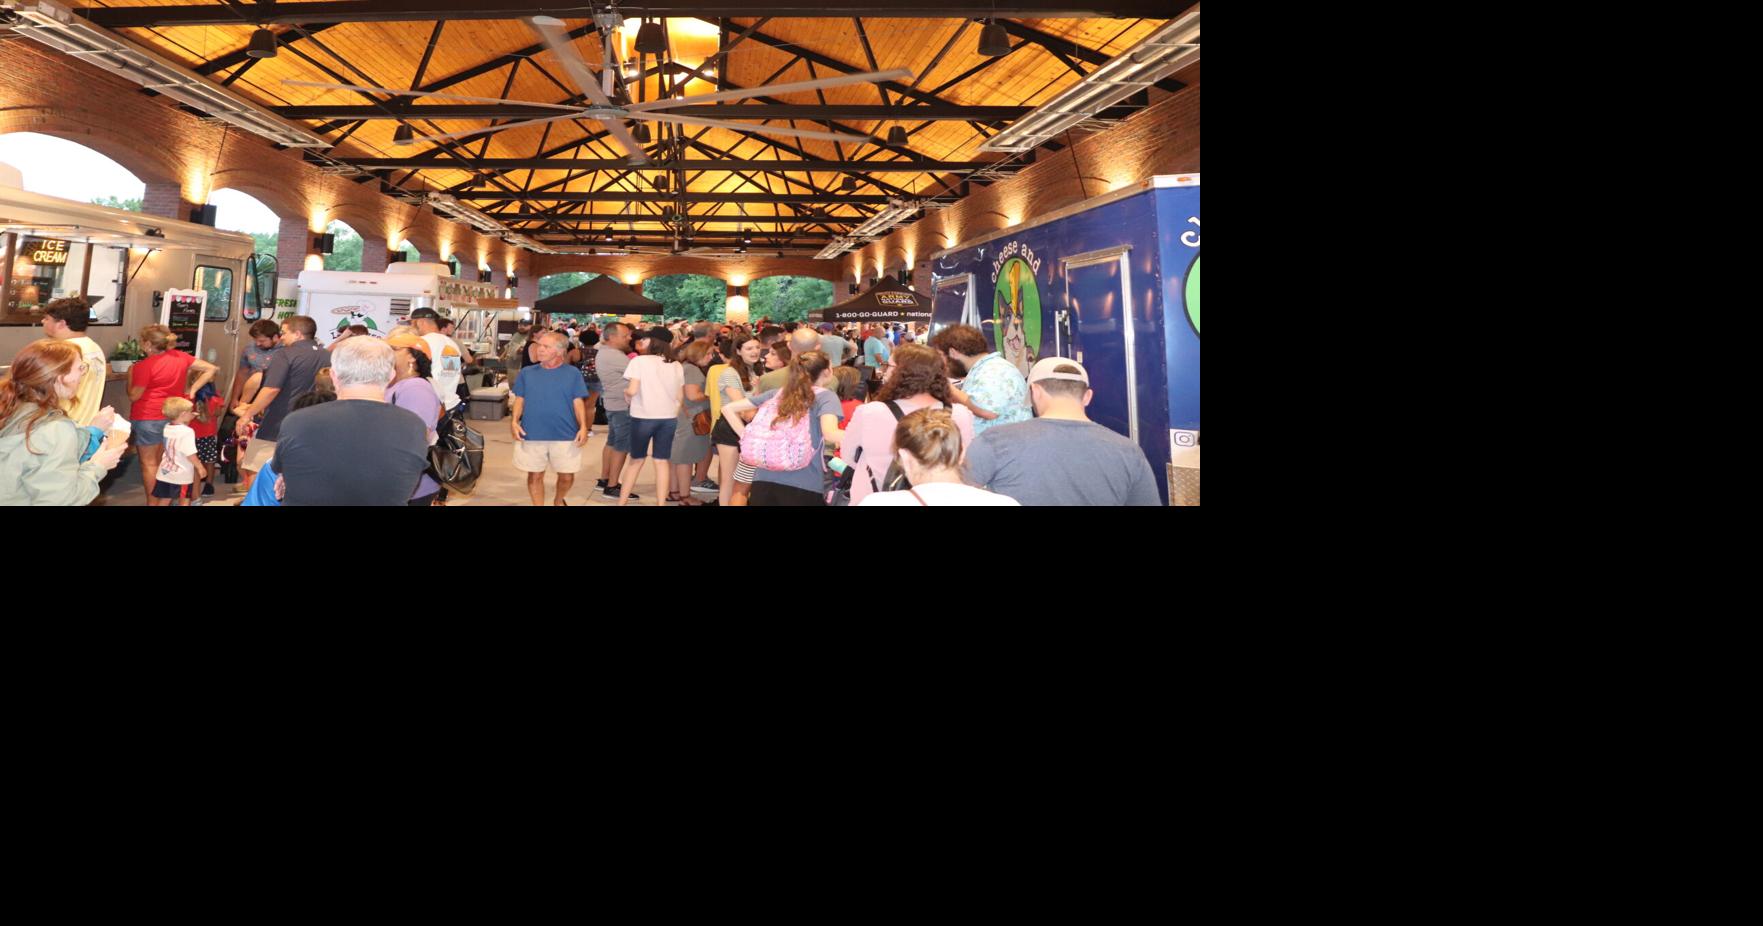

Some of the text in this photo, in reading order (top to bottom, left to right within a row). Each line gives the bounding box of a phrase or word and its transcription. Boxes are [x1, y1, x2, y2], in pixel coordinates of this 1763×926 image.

[41, 239, 66, 251] ICE
[33, 250, 68, 263] CREAM
[991, 240, 1041, 283] cheese and
